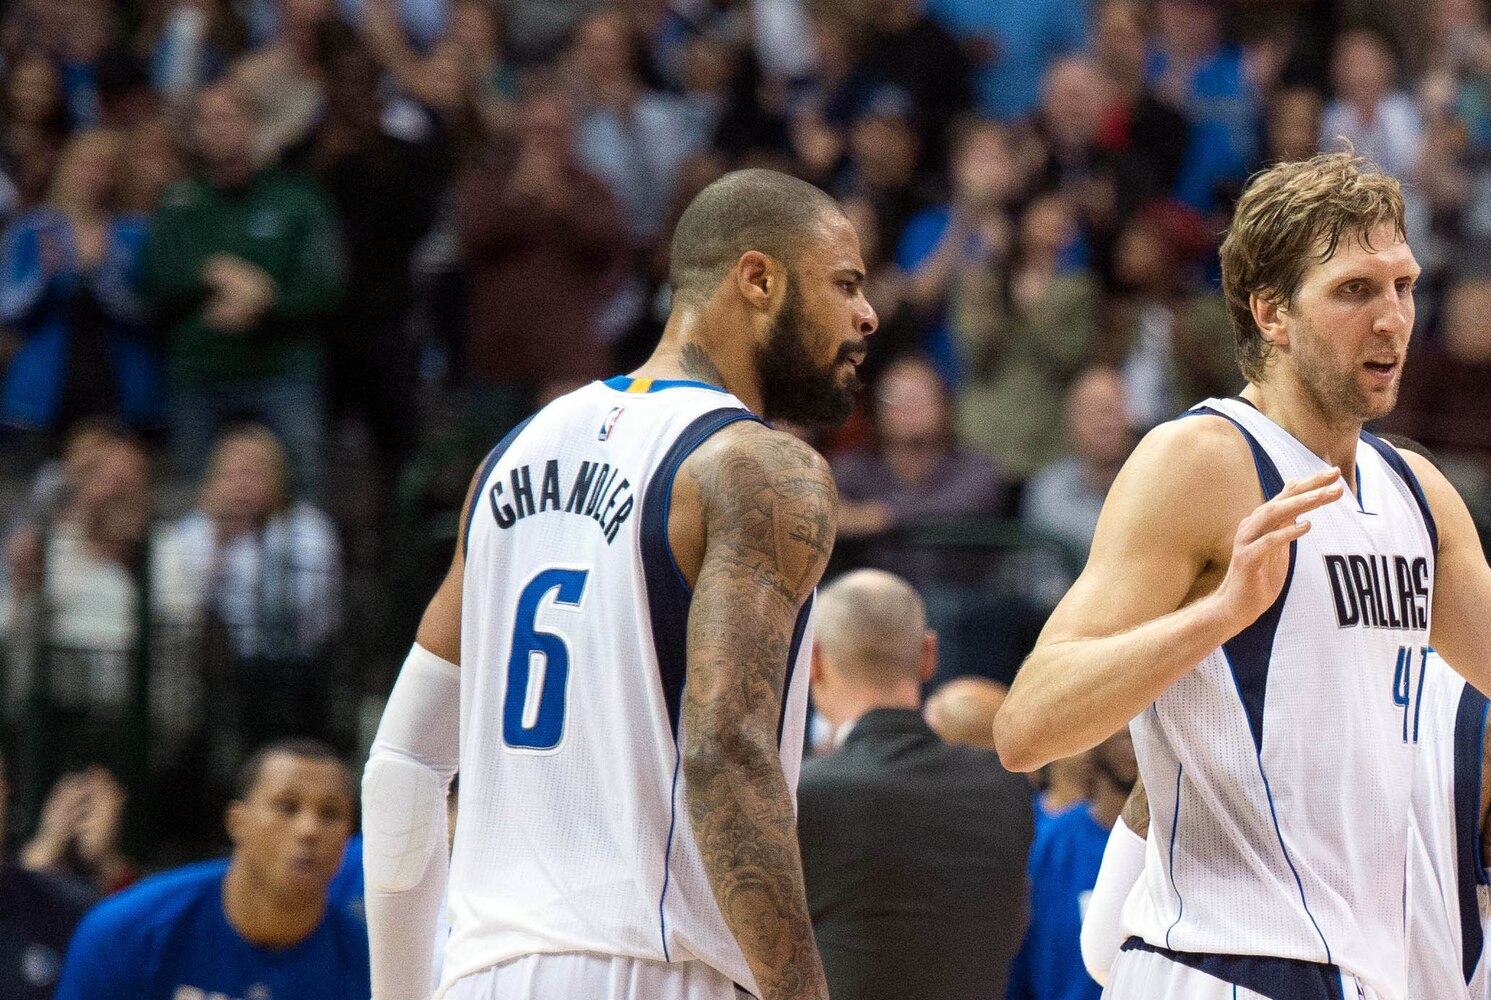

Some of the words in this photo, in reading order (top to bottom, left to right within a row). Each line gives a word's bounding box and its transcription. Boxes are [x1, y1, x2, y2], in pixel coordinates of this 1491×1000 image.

[489, 459, 634, 546] CHANDLER
[1322, 553, 1429, 631] DALLAS
[502, 567, 591, 752] 6
[1392, 645, 1428, 743] 41
